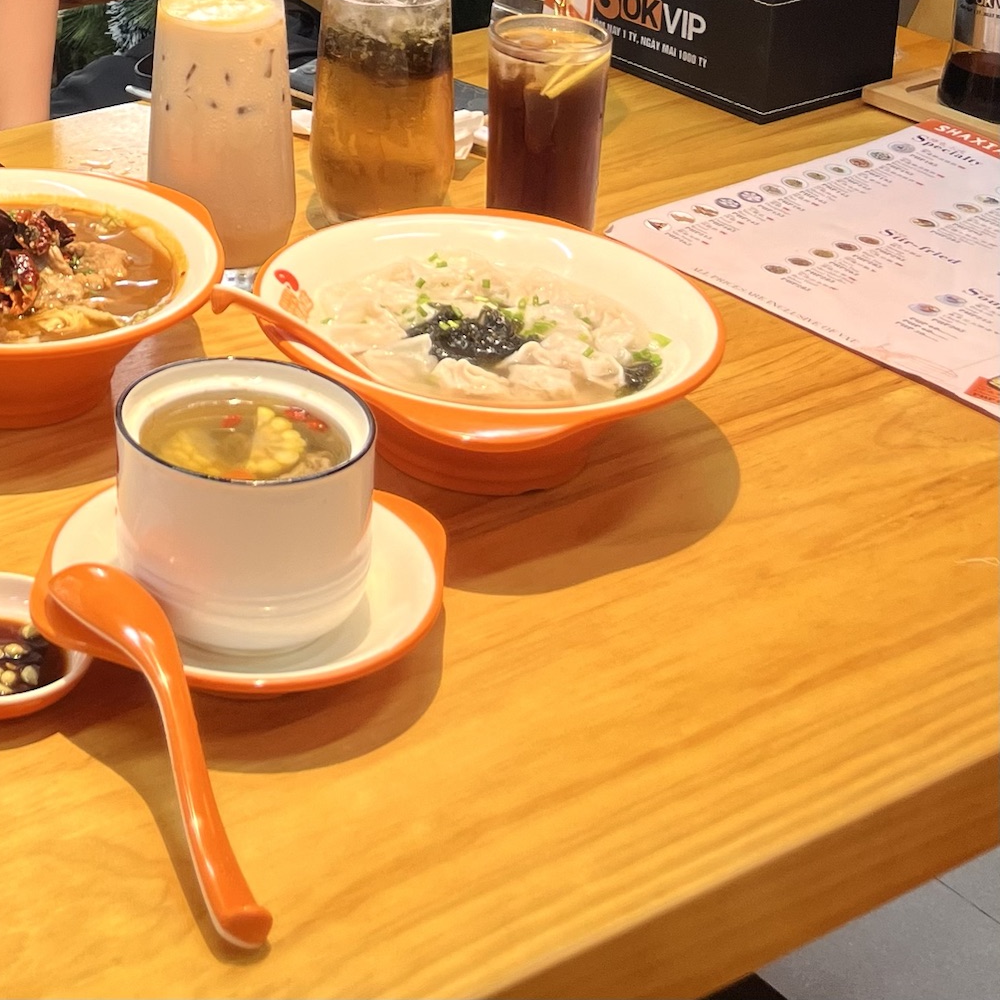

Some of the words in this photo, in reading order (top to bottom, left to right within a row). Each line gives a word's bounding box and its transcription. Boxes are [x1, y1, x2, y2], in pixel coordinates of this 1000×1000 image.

[623, 30, 627, 38] 1
[661, 43, 677, 58] MAI
[679, 49, 697, 65] 1000
[912, 134, 982, 166] Specialty
[879, 228, 962, 264] Stir-fried
[710, 274, 749, 292] PRICES
[748, 291, 767, 302] ARE
[766, 299, 821, 326] INCLUSIVE
[820, 324, 837, 333] OF
[961, 287, 1000, 307] Sou
